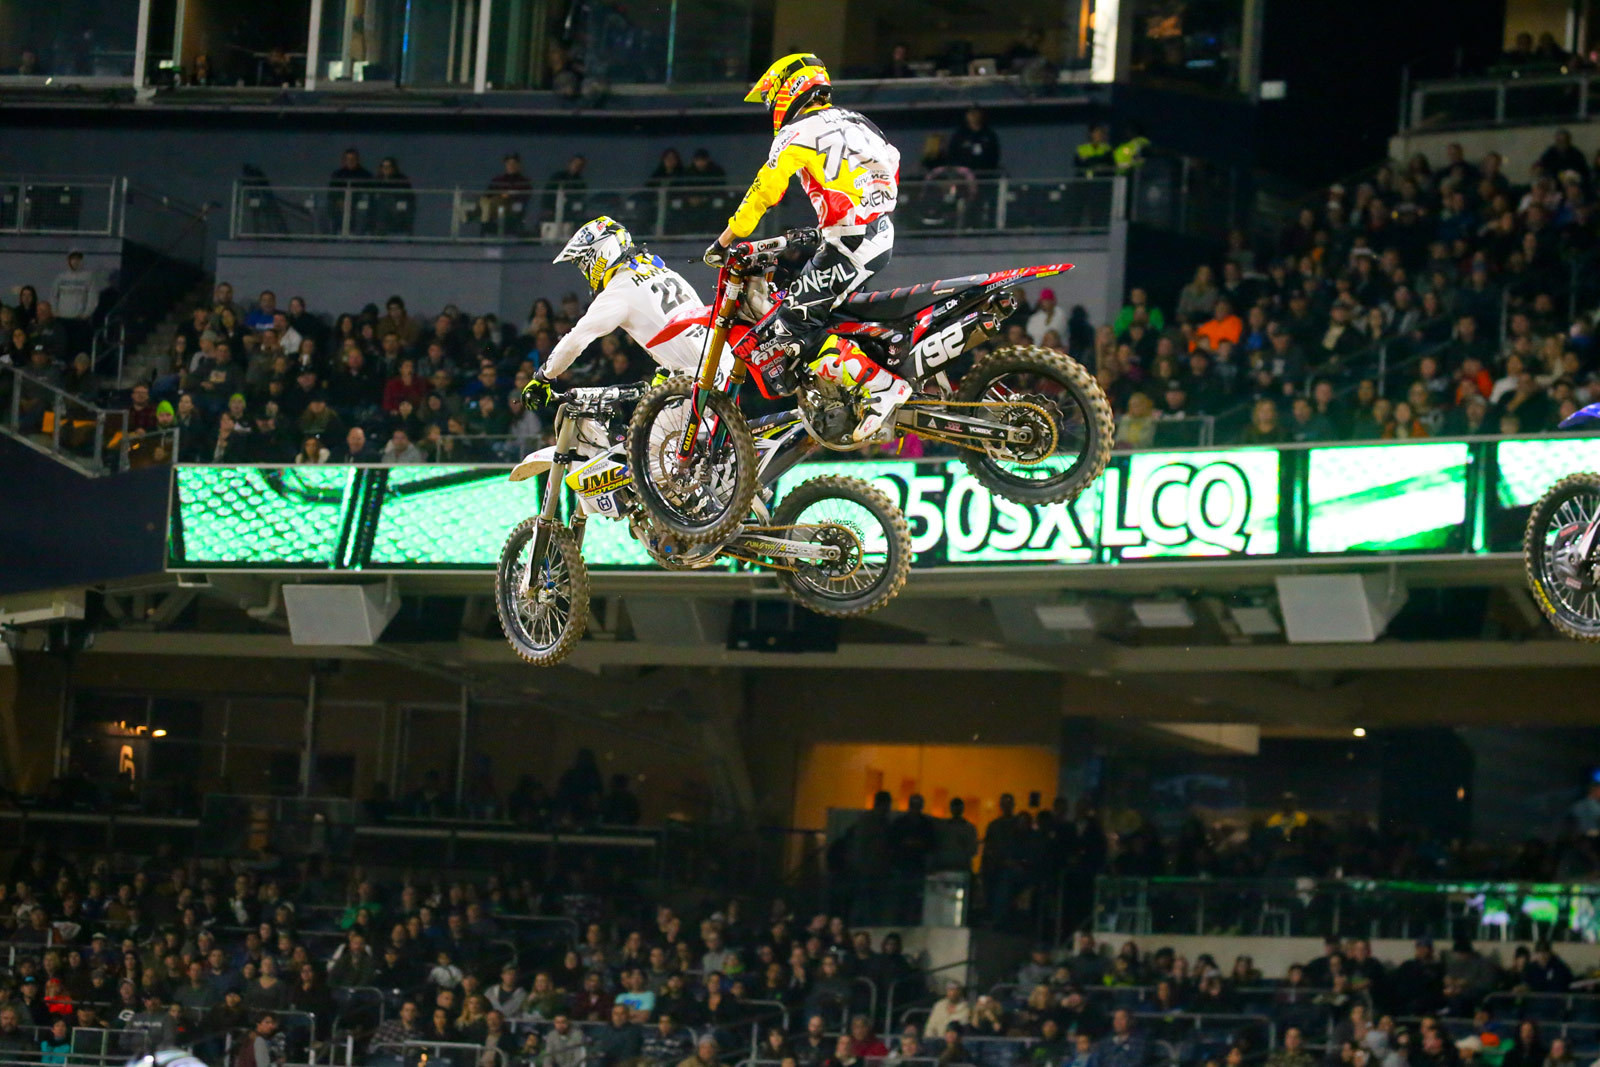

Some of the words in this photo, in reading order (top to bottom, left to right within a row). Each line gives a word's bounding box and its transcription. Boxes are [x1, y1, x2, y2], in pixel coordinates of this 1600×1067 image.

[908, 321, 966, 378] 792
[683, 423, 697, 451] GALFER
[751, 422, 776, 434] GUTS
[579, 466, 623, 493] JMC
[584, 477, 633, 498] MOTORS
[1101, 461, 1251, 553] LCQ
